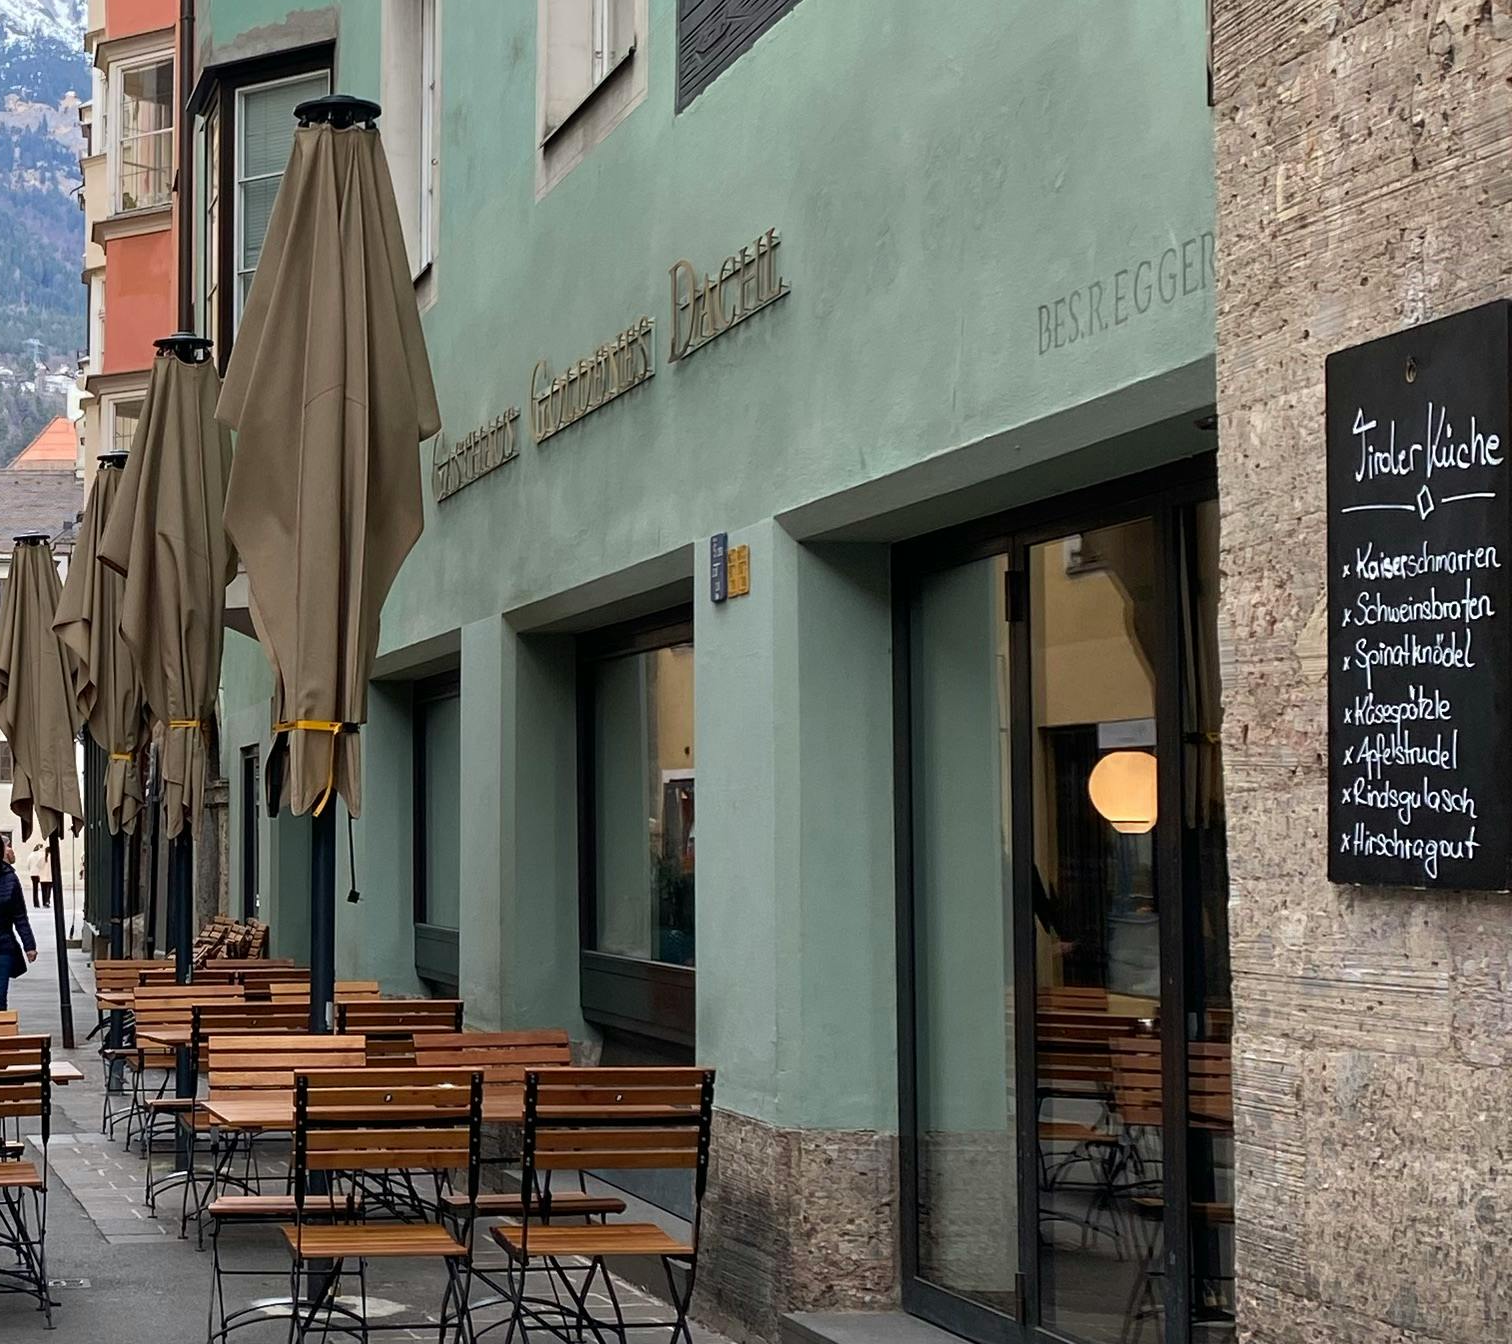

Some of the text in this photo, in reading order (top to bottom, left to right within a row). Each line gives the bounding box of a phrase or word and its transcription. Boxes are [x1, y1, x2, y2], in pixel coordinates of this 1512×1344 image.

[1353, 401, 1505, 482] Tiroler Küche
[1356, 540, 1501, 579] Kaiserschmarren
[1354, 577, 1495, 626] Schweinsbraten
[1355, 627, 1476, 690] Spinatknödel
[1356, 729, 1458, 780] Apfelstrudel
[1353, 776, 1478, 825] Rindsgulasch
[1353, 822, 1481, 879] Hirschragout
